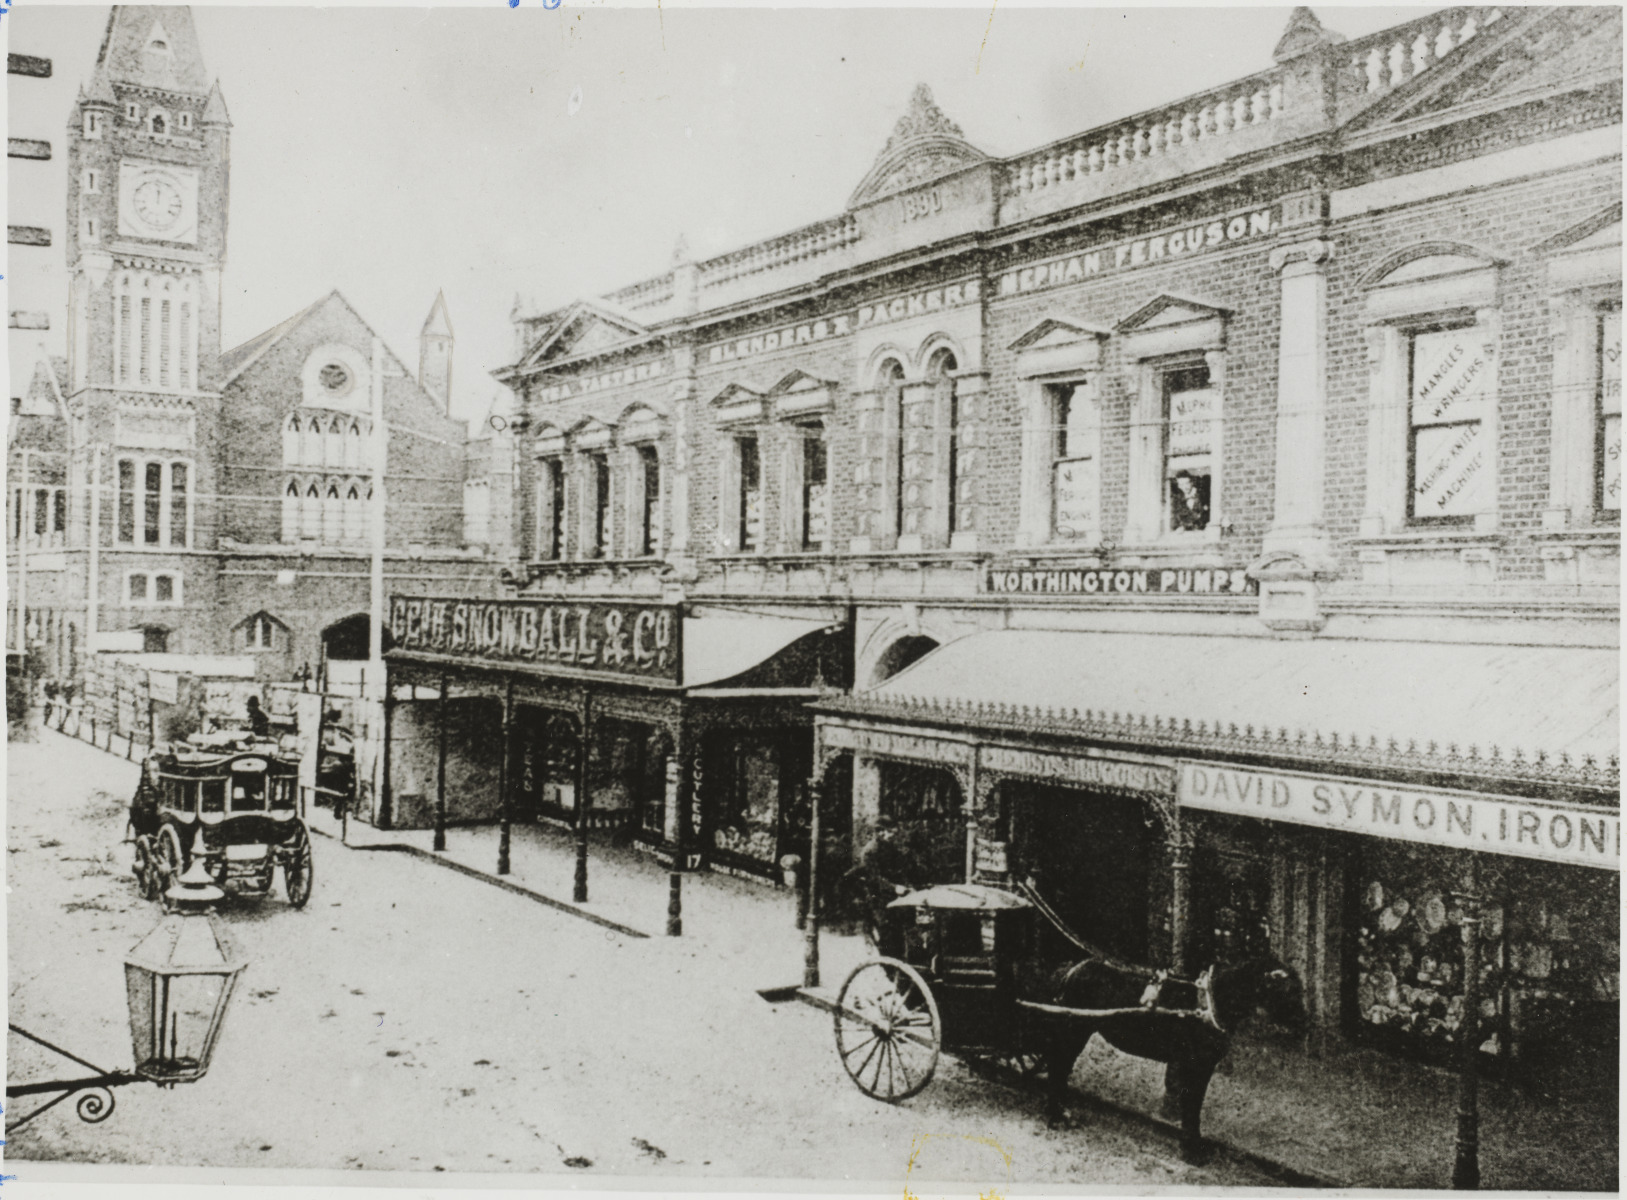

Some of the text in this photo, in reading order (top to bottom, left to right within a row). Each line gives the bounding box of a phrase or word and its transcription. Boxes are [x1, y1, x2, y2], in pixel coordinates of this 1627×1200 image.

[1001, 253, 1099, 293] MEPHAN
[709, 323, 828, 362] BLENDERS
[857, 282, 980, 325] PACKERS
[991, 570, 1148, 593] WORTHINGTON
[453, 603, 597, 663] SNOWBALL
[602, 609, 629, 665] &
[691, 758, 703, 835] CUTLERY
[1191, 768, 1290, 808] DAVID
[687, 854, 702, 869] 17
